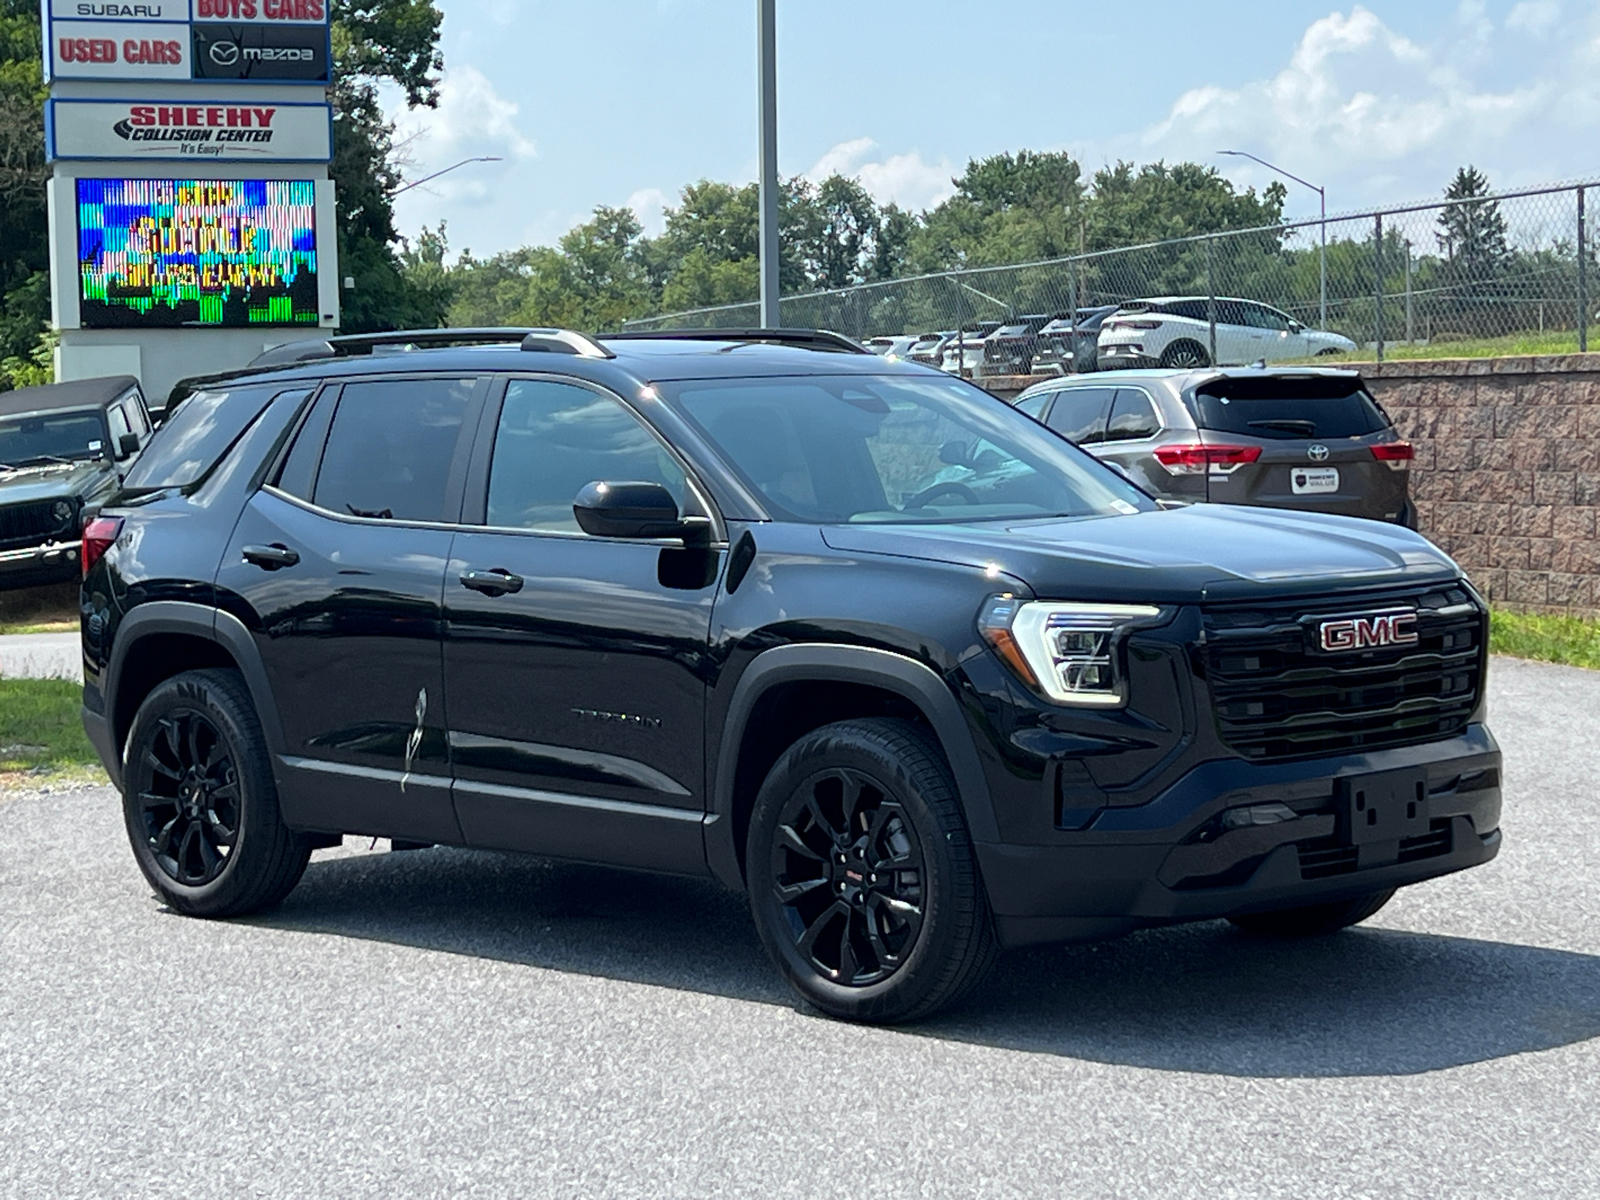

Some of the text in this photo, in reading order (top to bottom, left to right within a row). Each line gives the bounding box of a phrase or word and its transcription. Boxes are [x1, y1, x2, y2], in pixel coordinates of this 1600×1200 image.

[77, 4, 161, 17] SUBARU
[262, 0, 324, 21] CARS
[59, 38, 182, 65] USED CARS
[243, 47, 314, 61] mazda
[130, 106, 276, 127] SHEEHY
[131, 128, 273, 143] COLLISION CENTER
[180, 143, 195, 154] It's
[1320, 613, 1418, 651] GMC
